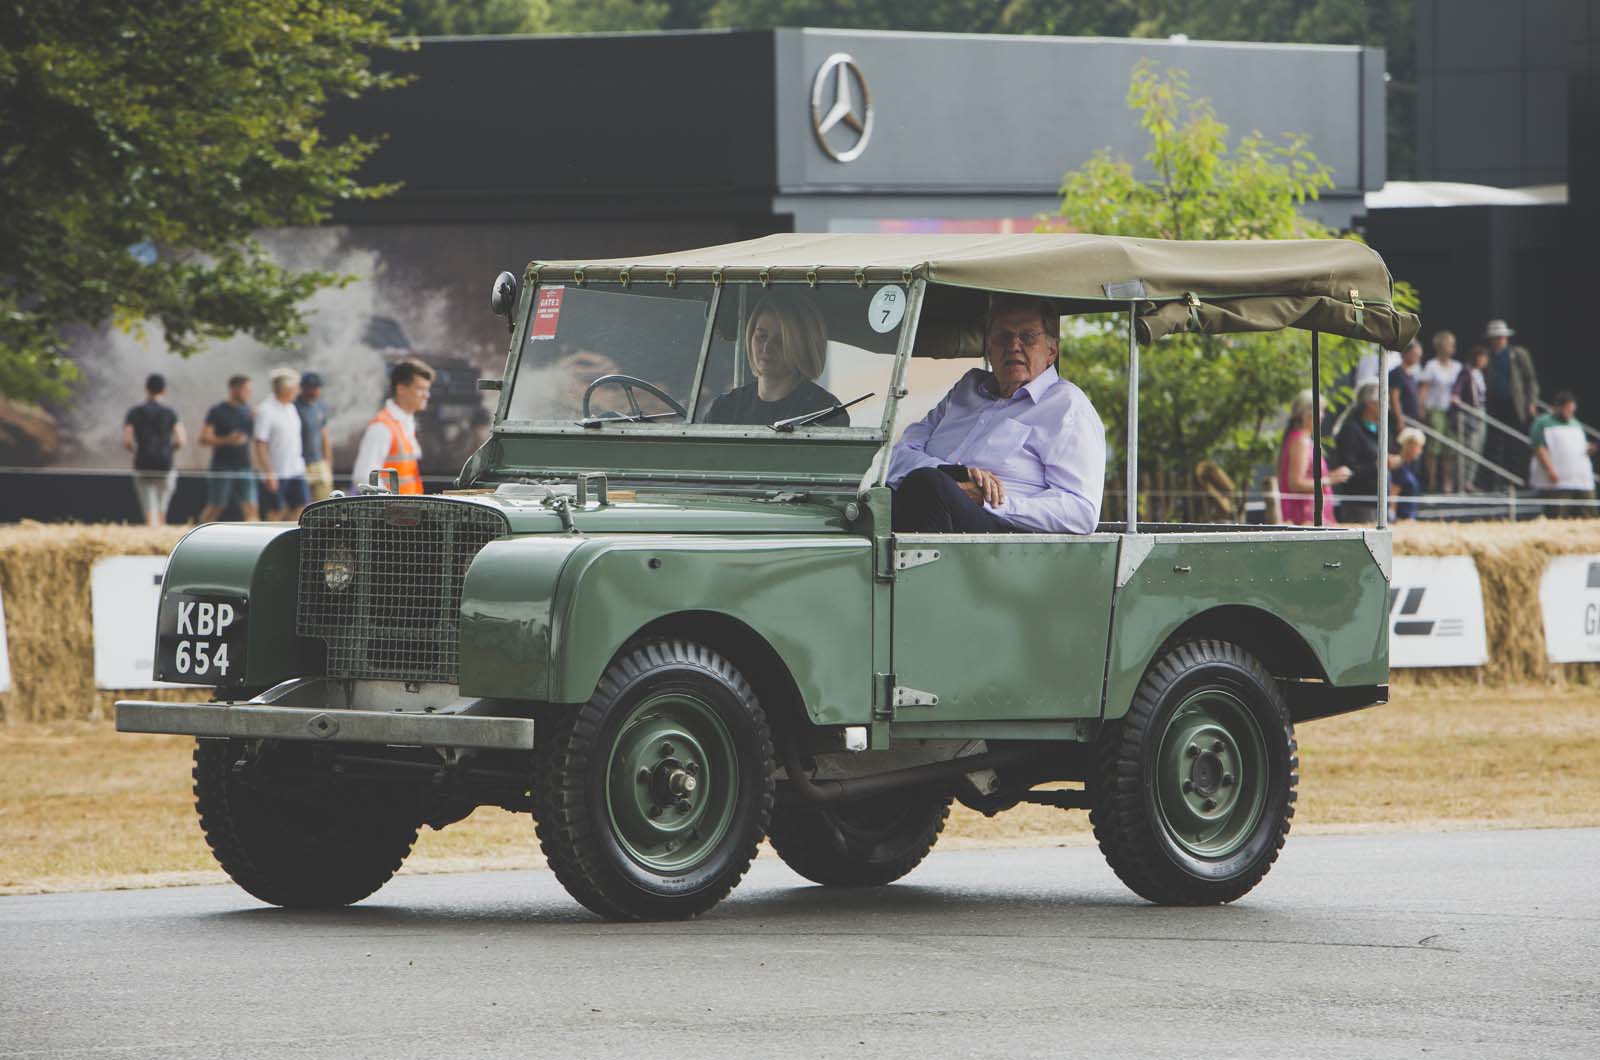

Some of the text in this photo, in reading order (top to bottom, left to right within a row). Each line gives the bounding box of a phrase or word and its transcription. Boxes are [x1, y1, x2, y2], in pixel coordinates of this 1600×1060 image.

[881, 310, 891, 324] 7
[176, 601, 234, 637] KBP
[175, 640, 230, 676] 654
